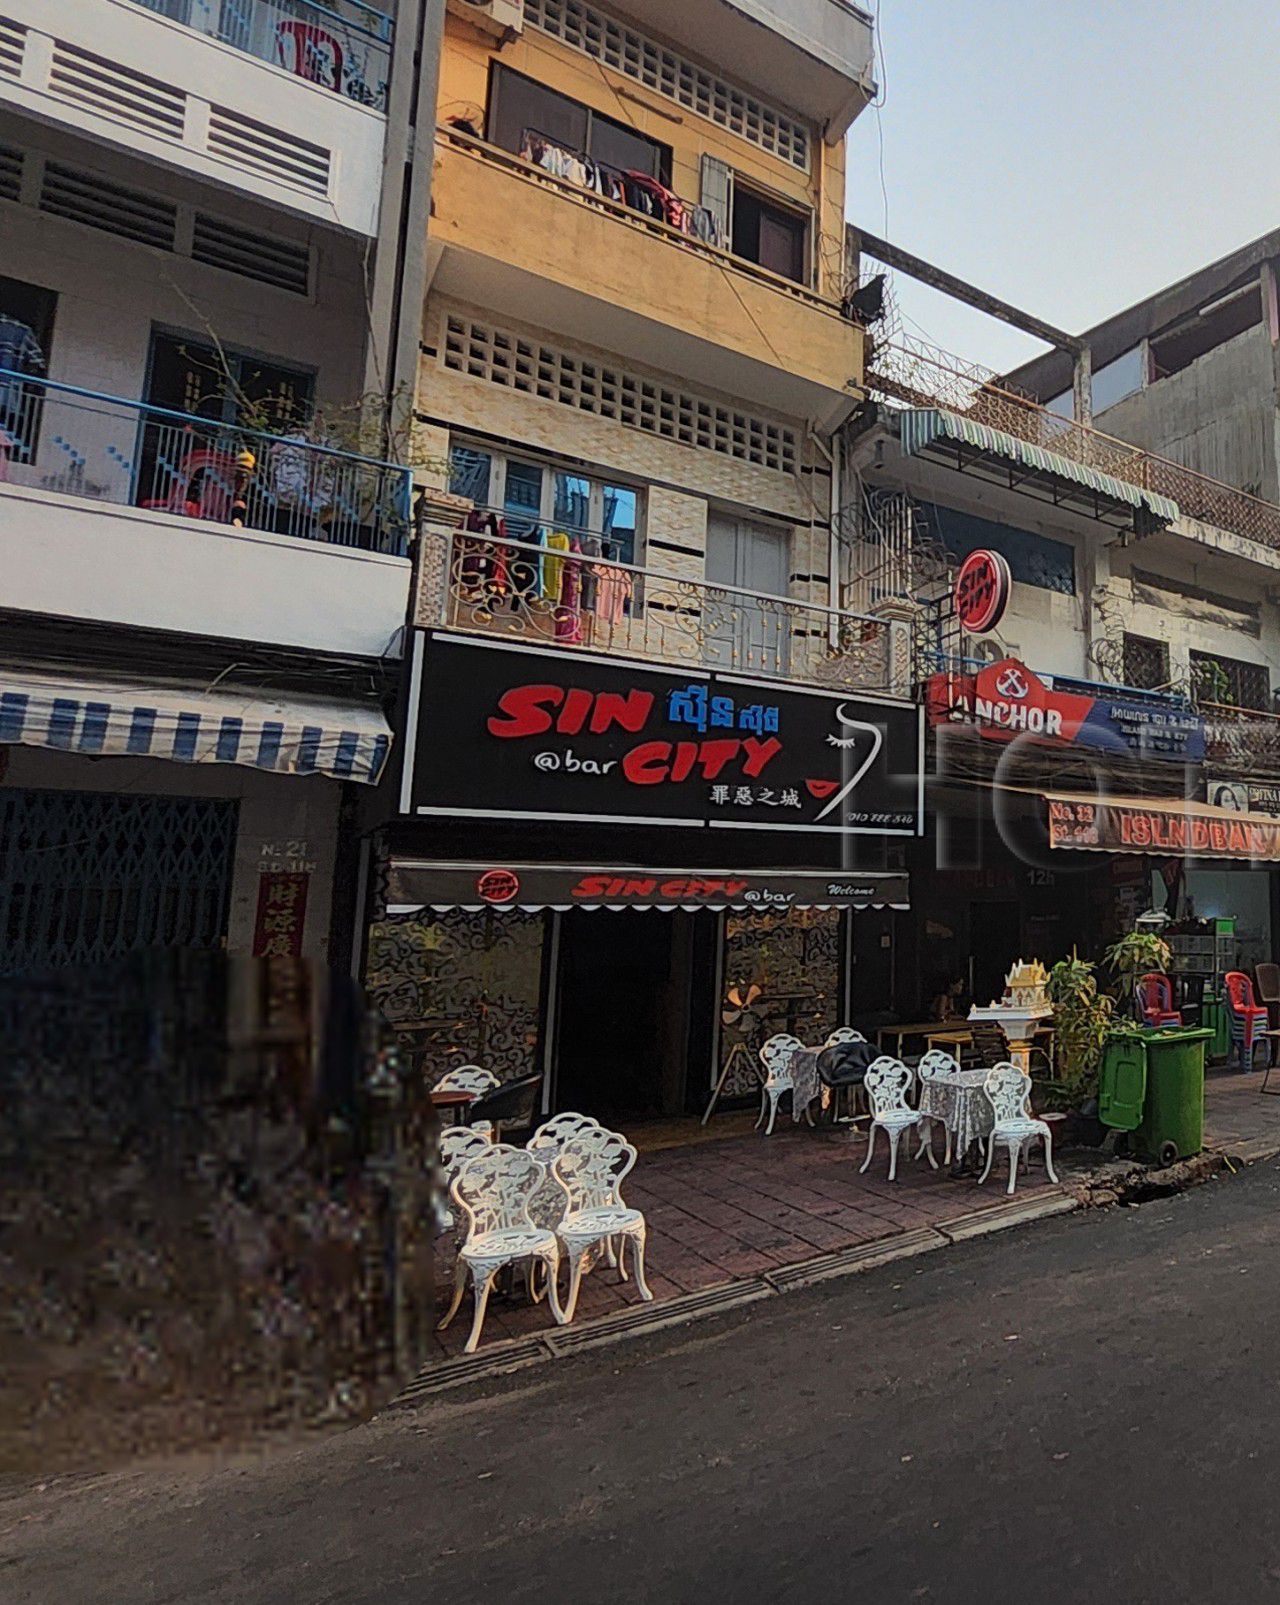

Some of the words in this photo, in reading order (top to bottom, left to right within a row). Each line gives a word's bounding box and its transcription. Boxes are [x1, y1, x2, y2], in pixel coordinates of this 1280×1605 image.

[487, 684, 654, 738] SIN
[949, 694, 1062, 735] ANCHOR
[534, 750, 617, 775] @bar
[623, 736, 783, 785] CITY
[709, 785, 802, 808] 罪惡之城
[571, 875, 659, 897] SIN
[661, 878, 748, 897] CITY
[743, 888, 796, 903] @bar
[826, 883, 875, 896] Welcome
